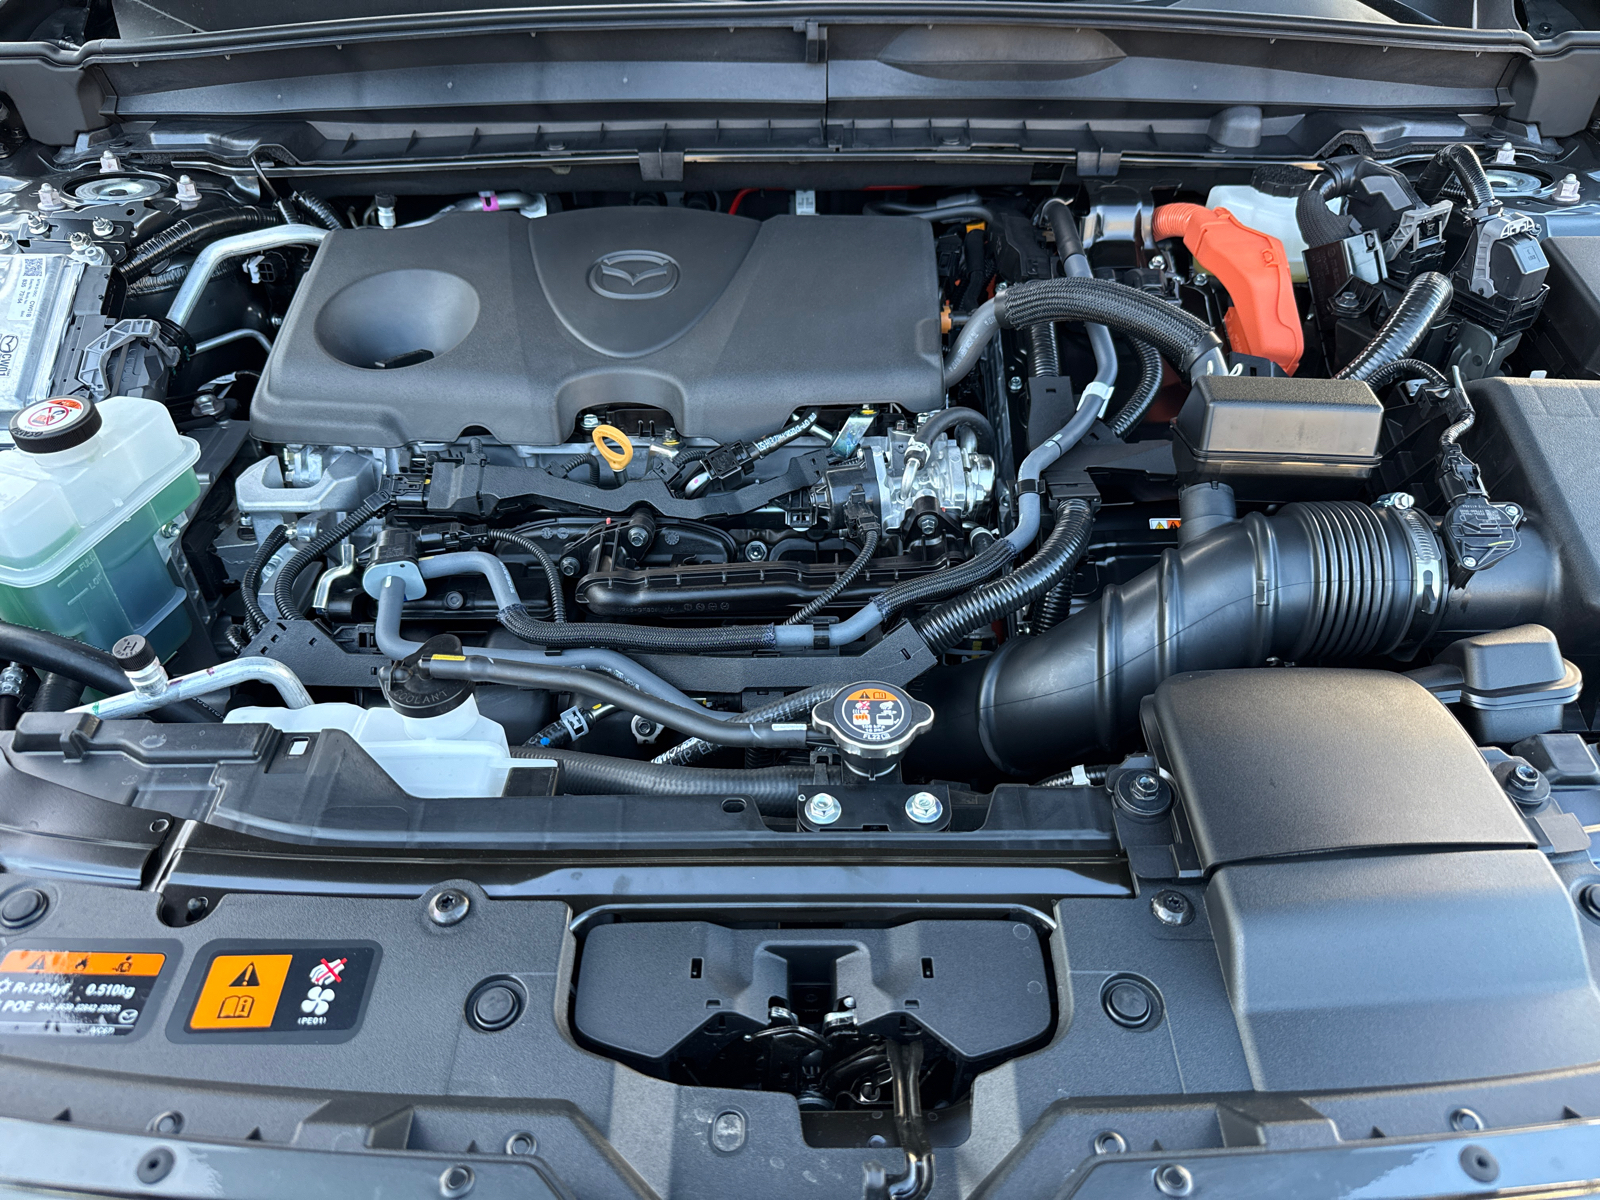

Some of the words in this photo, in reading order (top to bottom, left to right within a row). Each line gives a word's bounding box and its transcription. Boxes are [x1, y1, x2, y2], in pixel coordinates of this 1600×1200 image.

[78, 554, 97, 572] FULL
[393, 689, 448, 704] COOLANT
[12, 981, 71, 997] R-1234yf
[85, 982, 136, 999] 0.510kg
[2, 999, 35, 1012] POE
[297, 1016, 327, 1026] (PE01)
